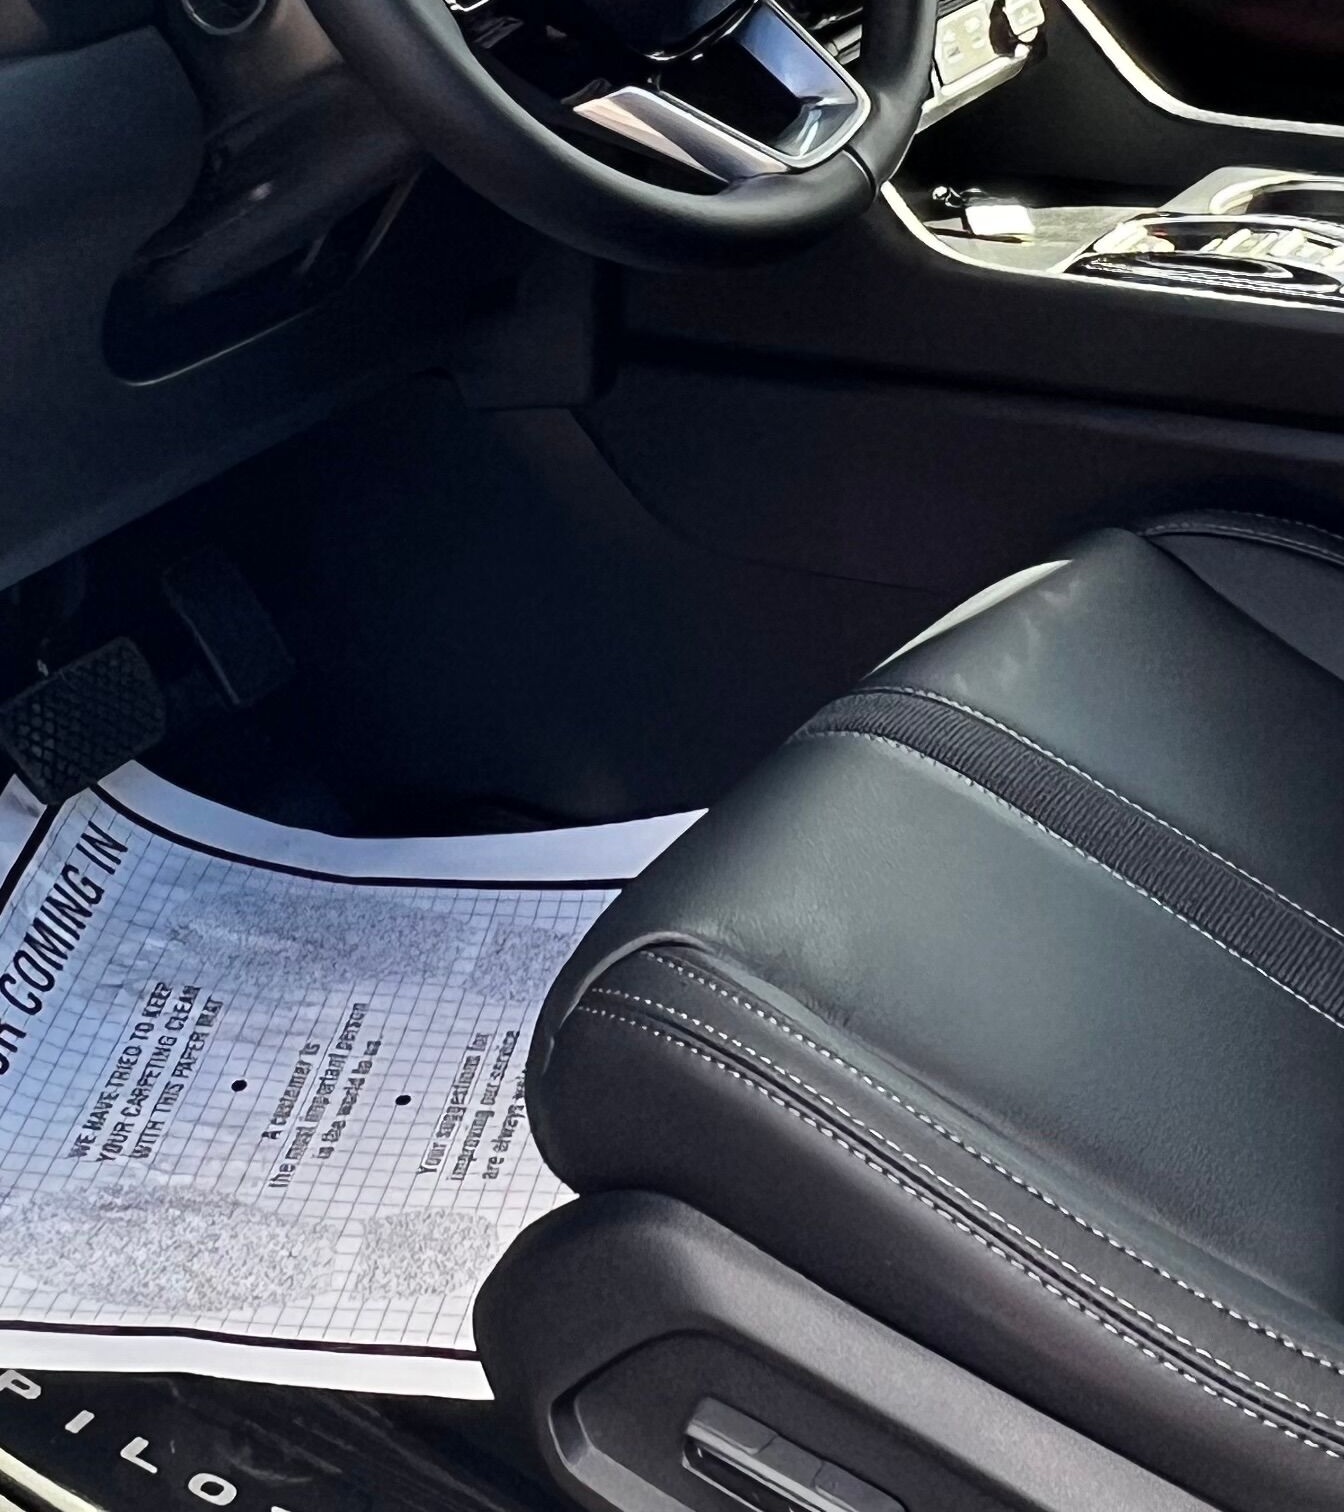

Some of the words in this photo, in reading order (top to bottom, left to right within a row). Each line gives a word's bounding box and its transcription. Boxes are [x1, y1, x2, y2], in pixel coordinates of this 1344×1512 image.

[75, 819, 129, 876] IN
[141, 982, 174, 1018] KEEP
[129, 1022, 155, 1041] TO
[95, 1120, 135, 1162] YOUR
[120, 1035, 178, 1117] CARPETING
[164, 985, 202, 1031] CLEAN
[105, 1045, 142, 1088] TRIED
[82, 1090, 119, 1131] HAVE
[129, 1119, 165, 1159] WITH
[152, 1081, 185, 1113] THIS
[171, 1030, 209, 1078] PAPER
[66, 1133, 96, 1159] WE
[260, 1129, 283, 1141] A
[267, 1162, 296, 1188] the
[417, 1141, 446, 1175] Your
[481, 1155, 505, 1179] are
